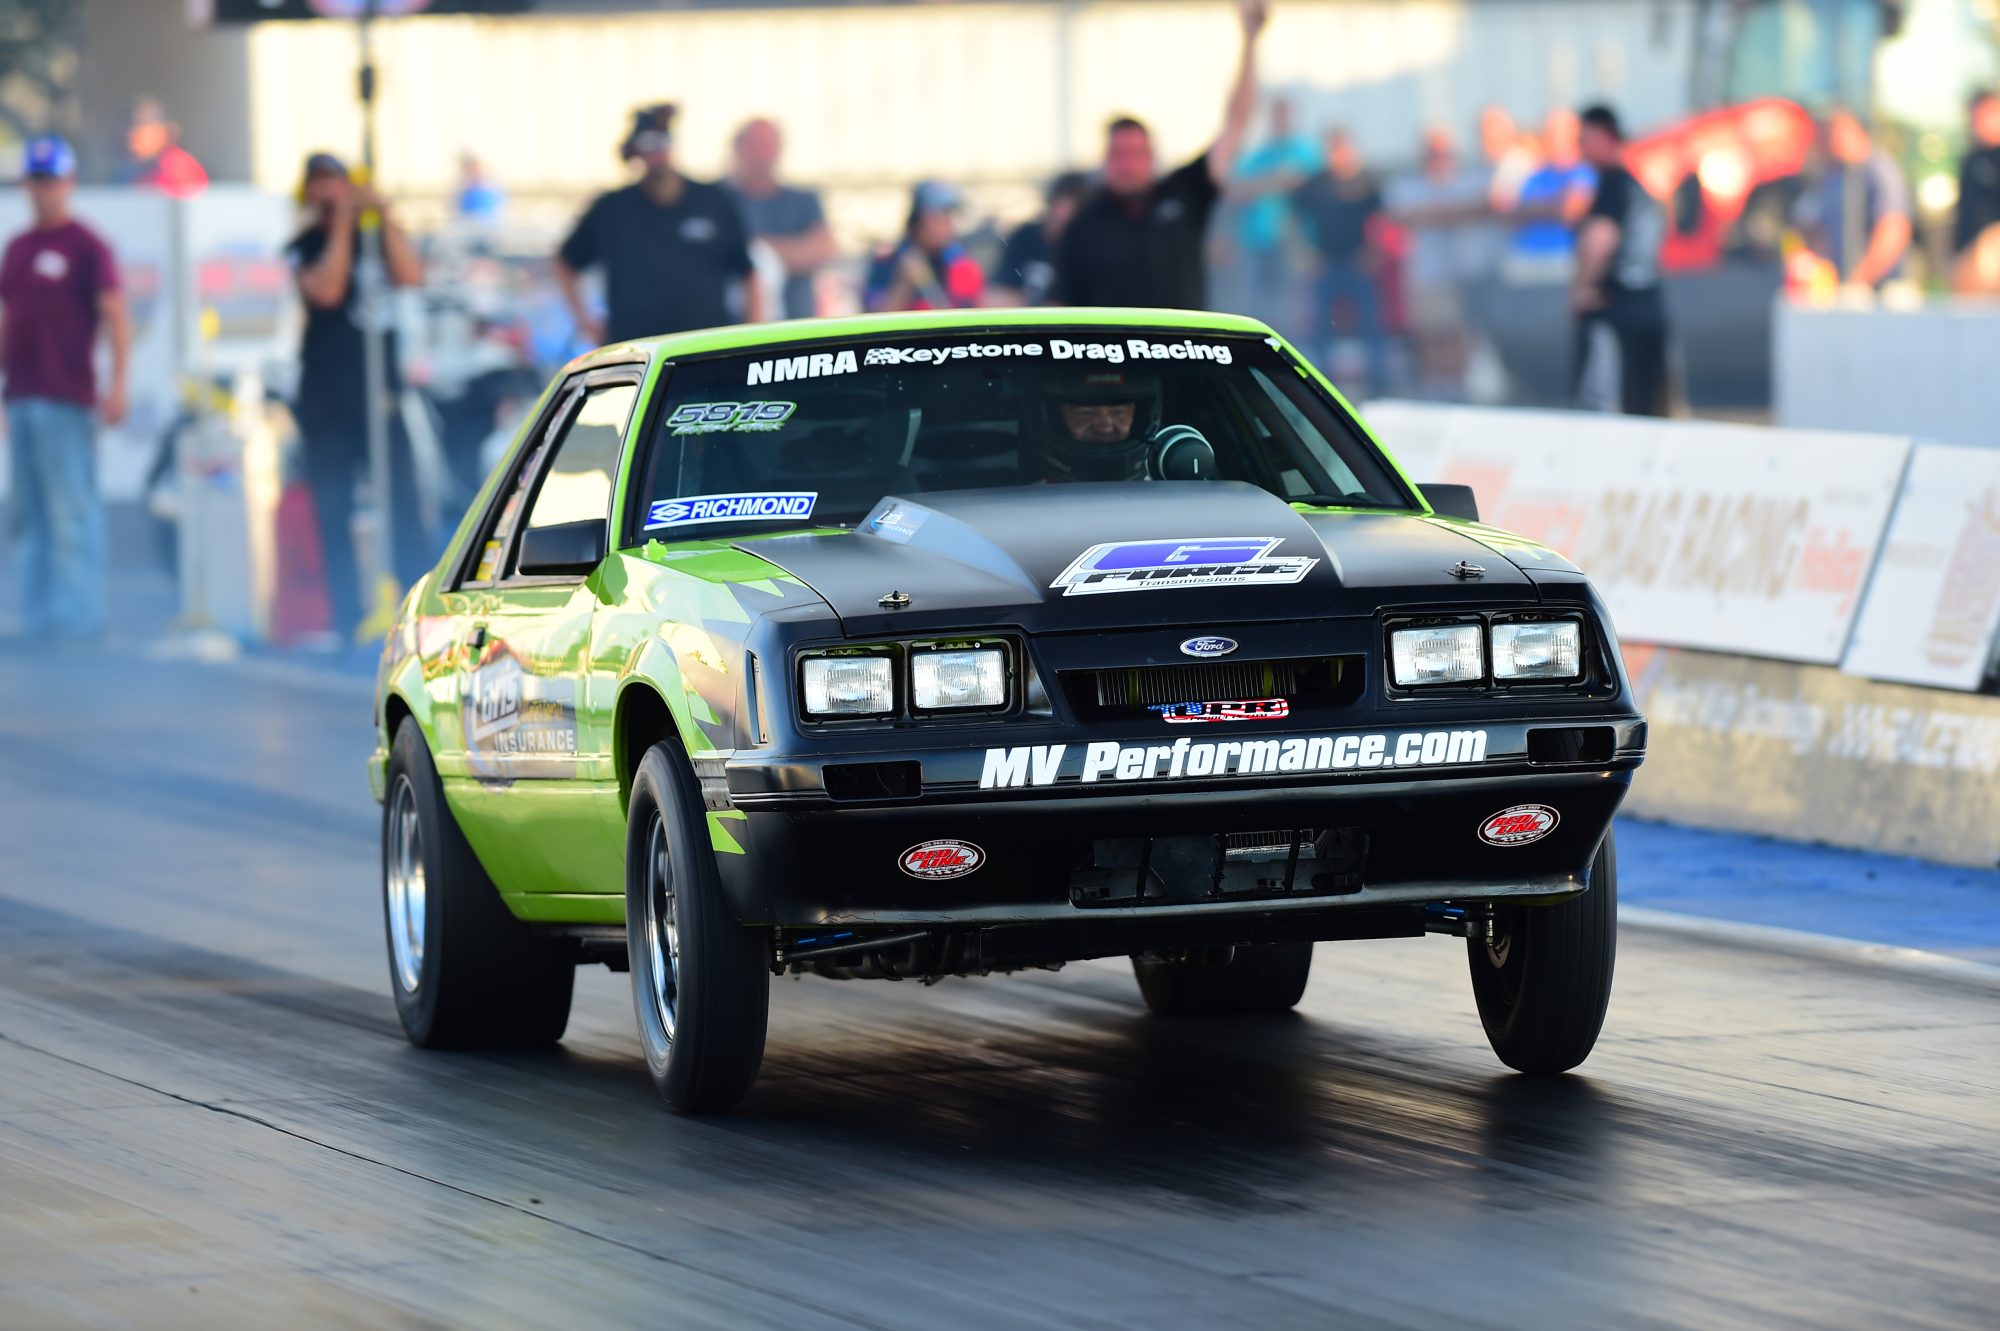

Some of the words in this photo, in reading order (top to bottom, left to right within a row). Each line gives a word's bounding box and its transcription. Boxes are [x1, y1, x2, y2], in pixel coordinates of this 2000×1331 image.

[747, 350, 858, 386] NMRA
[893, 342, 1043, 365] Keystone
[1049, 339, 1125, 363] Drag
[1126, 339, 1233, 365] Racing
[666, 401, 797, 427] 5819
[690, 497, 810, 519] RICHMOND
[1138, 576, 1246, 587] Transmissions
[1194, 639, 1225, 651] Ford
[495, 729, 575, 753] INSURANCE
[979, 744, 1066, 790] MV
[1080, 729, 1488, 783] Performance.com
[908, 848, 954, 862] RED
